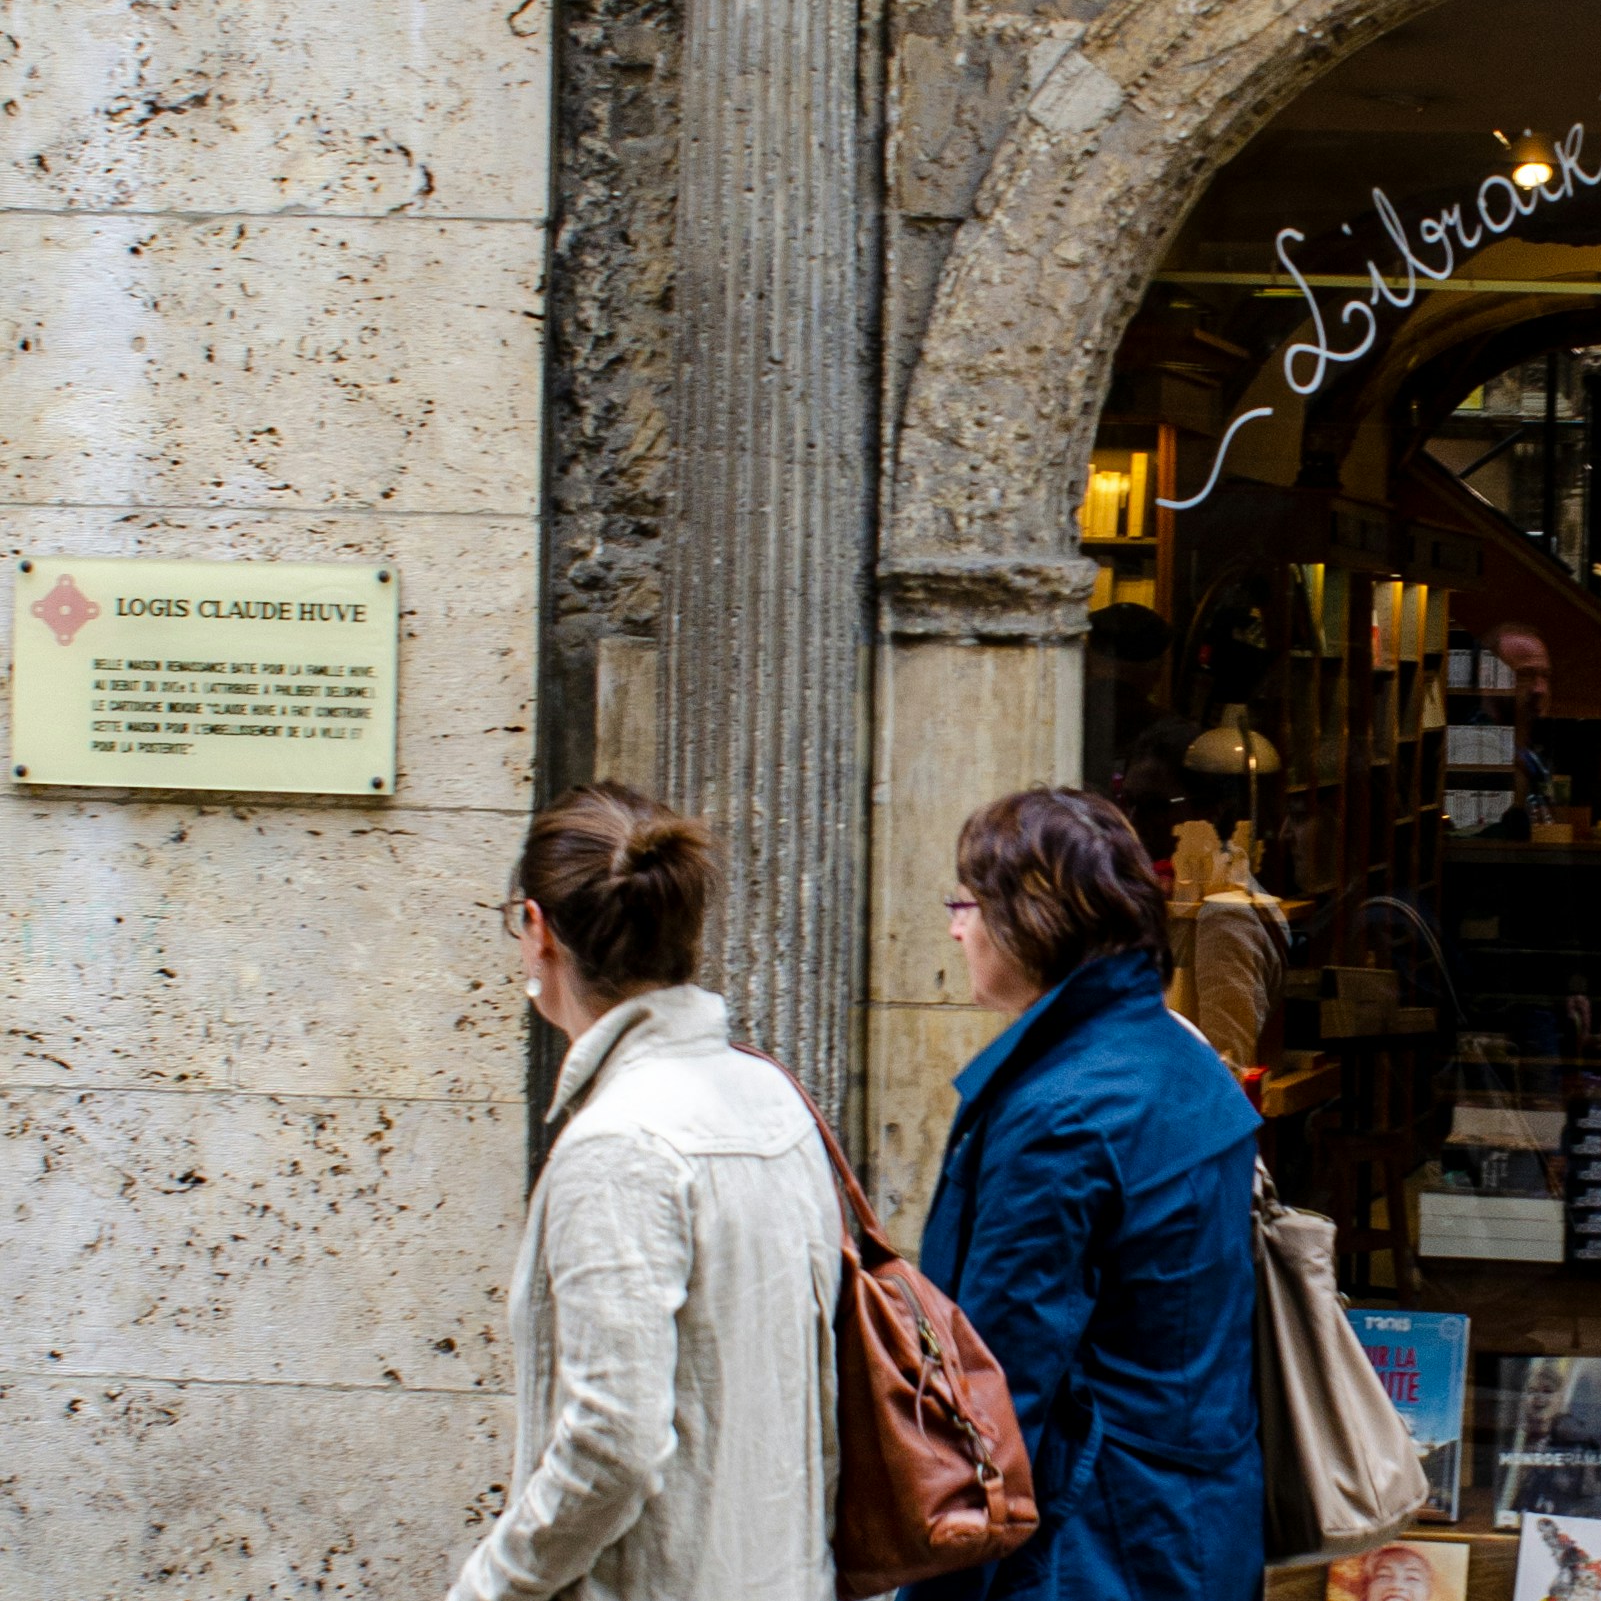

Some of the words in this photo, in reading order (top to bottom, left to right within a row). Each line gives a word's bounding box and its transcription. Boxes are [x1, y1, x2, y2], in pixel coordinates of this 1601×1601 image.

[116, 597, 191, 618] LOGIS
[199, 599, 293, 621] CLAUDE
[299, 602, 367, 623] HUVE
[1394, 1345, 1416, 1368] LA
